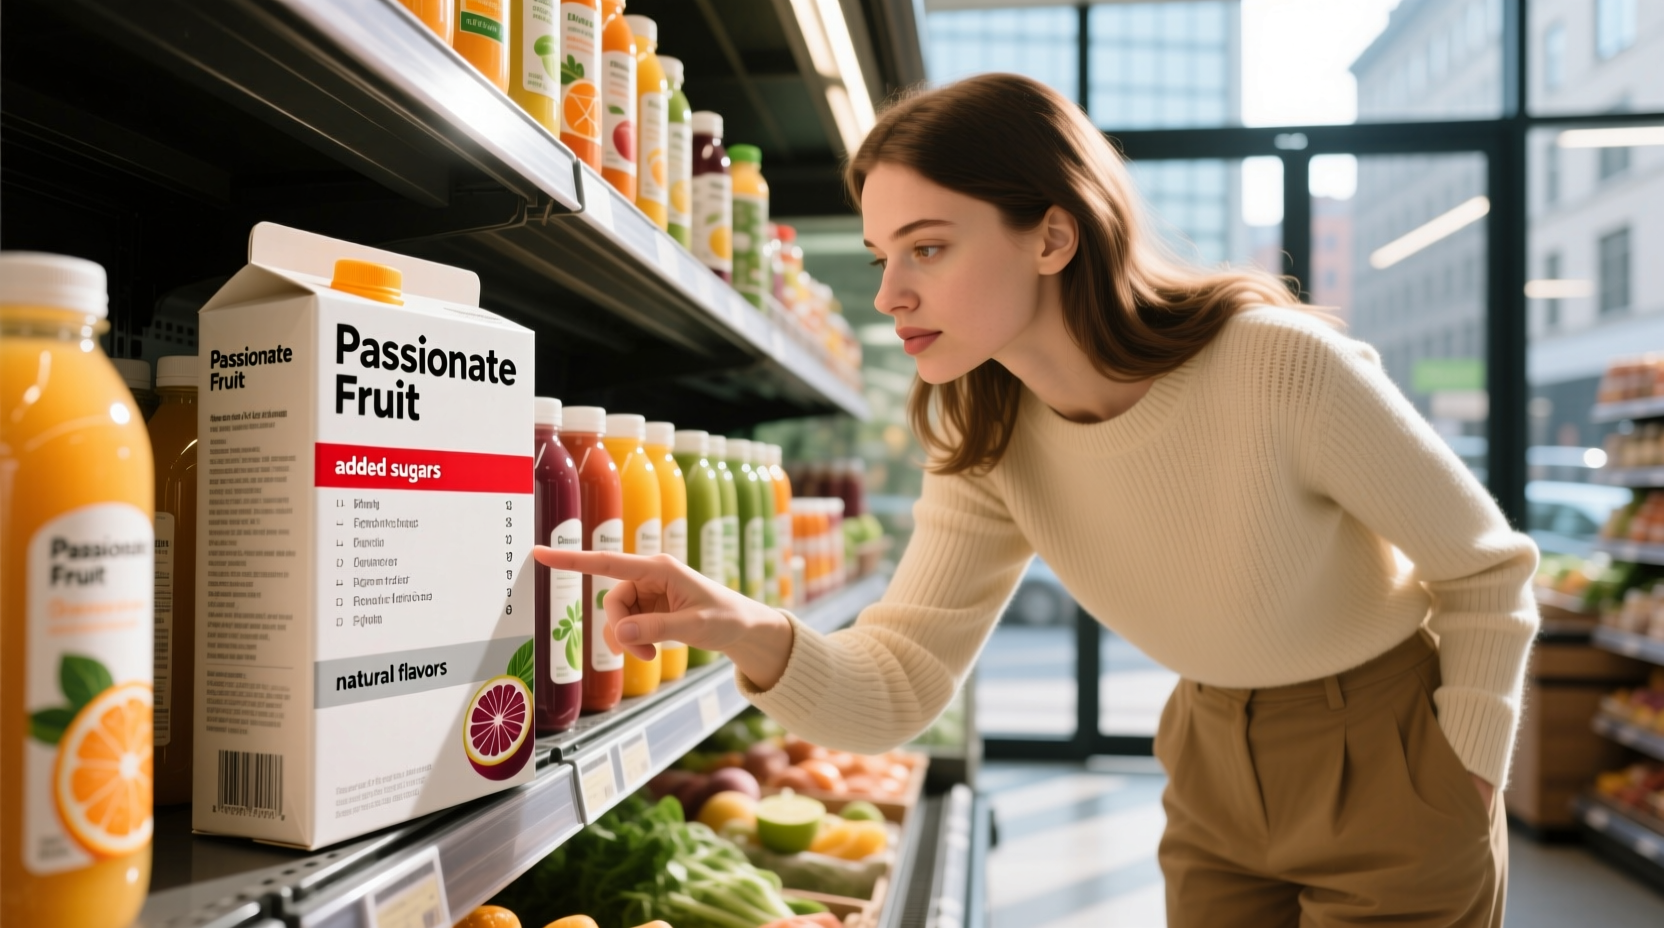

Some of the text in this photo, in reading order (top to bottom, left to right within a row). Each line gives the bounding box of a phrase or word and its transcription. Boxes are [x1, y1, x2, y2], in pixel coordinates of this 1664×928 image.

[210, 345, 293, 370] Passionate
[336, 323, 517, 386] Passionate
[210, 371, 246, 391] Fruit
[335, 373, 420, 421] Fruit
[334, 455, 442, 483] added sugars
[336, 661, 448, 691] natural flavors
